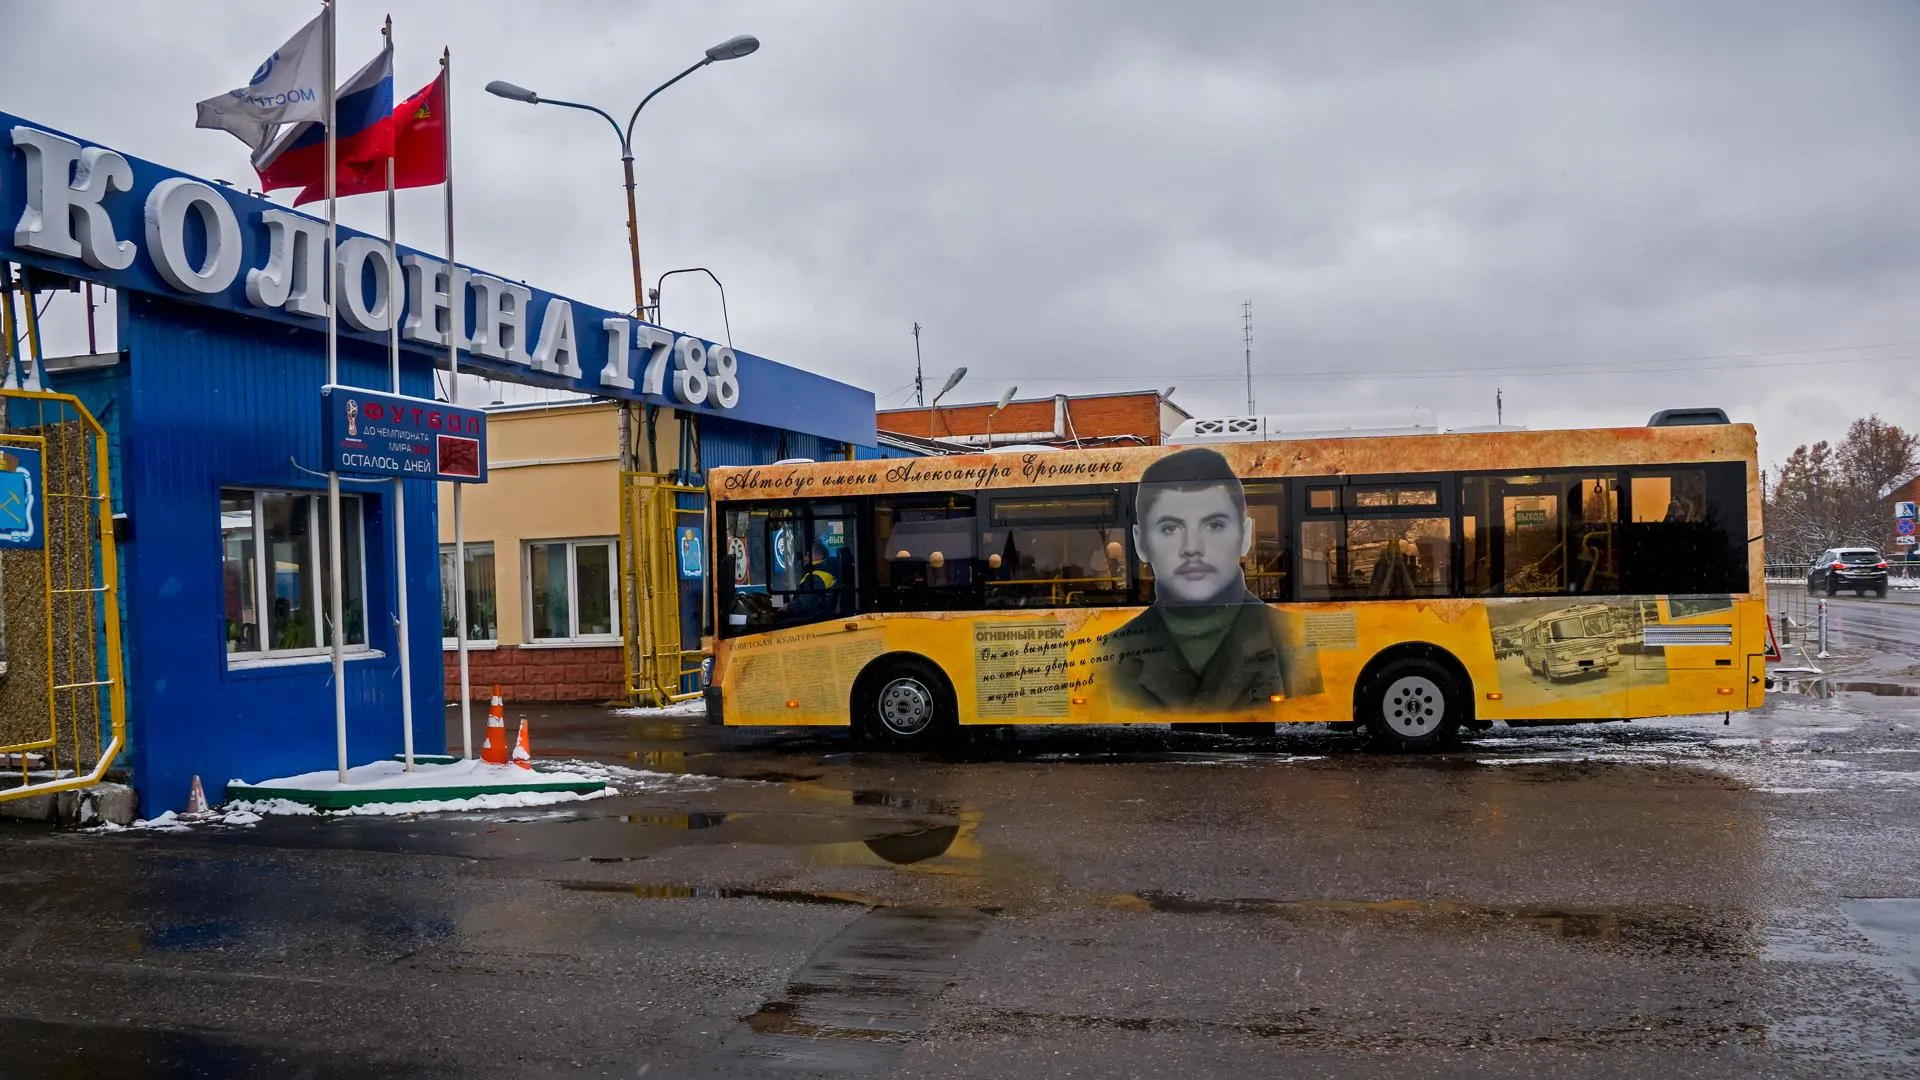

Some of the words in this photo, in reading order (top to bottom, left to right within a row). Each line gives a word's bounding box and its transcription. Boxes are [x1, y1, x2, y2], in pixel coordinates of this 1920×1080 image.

[11, 125, 582, 379] КОЛОННА
[600, 317, 740, 409] 1788
[364, 402, 479, 434] ФУТБОЛ
[363, 426, 376, 436] ДО
[377, 427, 429, 441] ЧЕМПИОНАТА
[388, 442, 412, 453] МИРА
[342, 453, 399, 470] ОСТАЛОСЬ
[403, 459, 431, 473] ДНЕЙ
[724, 468, 814, 495] Автобус
[822, 473, 878, 486] имени
[886, 461, 1012, 487] Александра
[1022, 453, 1124, 483] Ерошкина
[1517, 512, 1545, 521] ВЫХОД
[829, 535, 844, 545] ВЫХ
[776, 632, 817, 645] КУЛЬТУРА
[976, 629, 1035, 641] ОГНЕННЫЙ
[1037, 628, 1065, 639] РЕЙС
[981, 647, 997, 661] Он
[1000, 649, 1020, 658] мог
[1023, 637, 1092, 656] выпрыгнуть
[1096, 633, 1108, 646] из
[983, 674, 996, 682] но
[1000, 665, 1041, 680] открыл
[1045, 658, 1075, 677] двери
[1091, 654, 1115, 663] спас
[987, 687, 1026, 704] жизней
[1030, 672, 1095, 695] пассажиров
